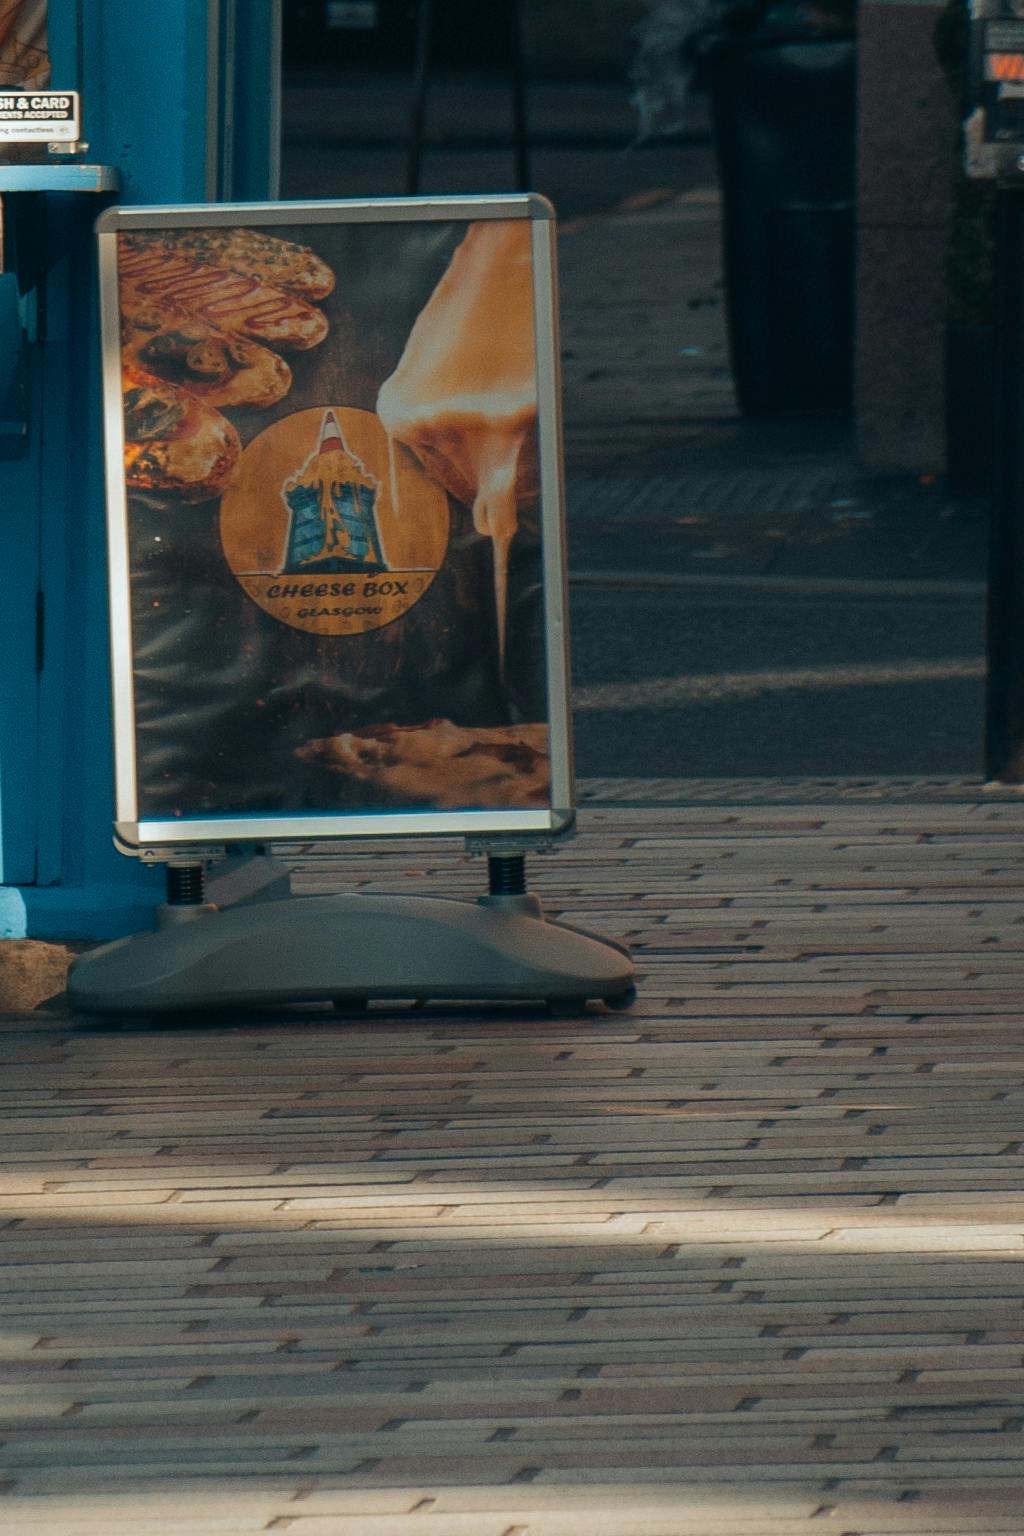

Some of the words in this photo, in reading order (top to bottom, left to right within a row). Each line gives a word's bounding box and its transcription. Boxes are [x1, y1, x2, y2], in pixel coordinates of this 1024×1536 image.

[16, 96, 29, 110] &
[31, 96, 70, 110] CARD
[24, 110, 68, 120] ACCEPTED
[266, 581, 356, 599] CHEESE
[363, 580, 409, 598] BOX
[297, 606, 383, 619] GLASGOW
